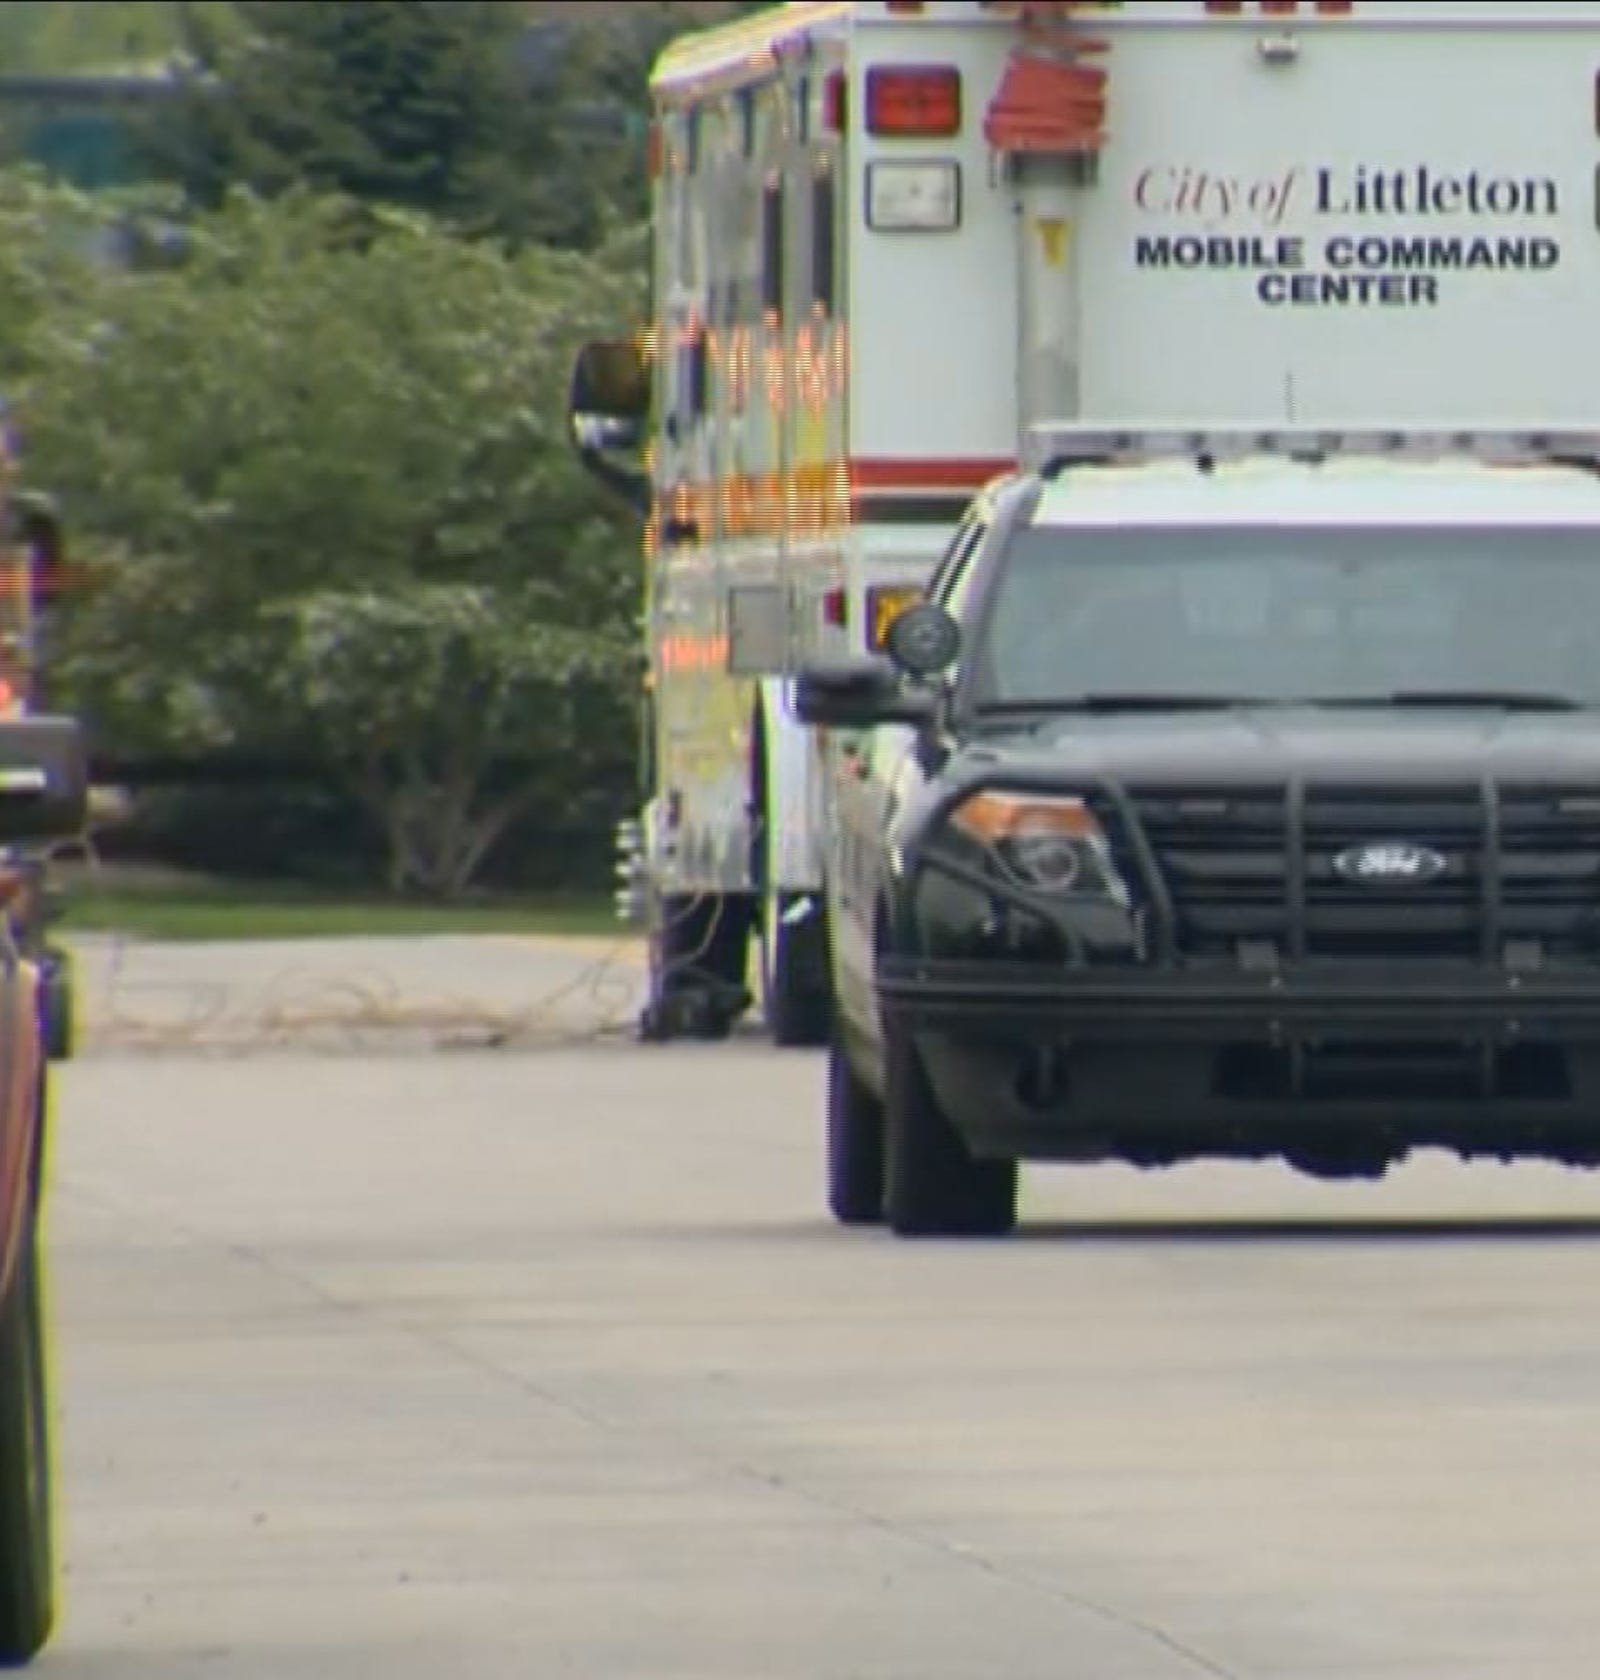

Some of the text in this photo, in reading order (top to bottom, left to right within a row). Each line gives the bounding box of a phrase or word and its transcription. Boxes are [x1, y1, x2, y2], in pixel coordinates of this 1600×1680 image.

[1136, 163, 1558, 229] City of Littleton
[1136, 237, 1560, 268] MOBILE COMMAND
[1257, 273, 1439, 304] CENTER
